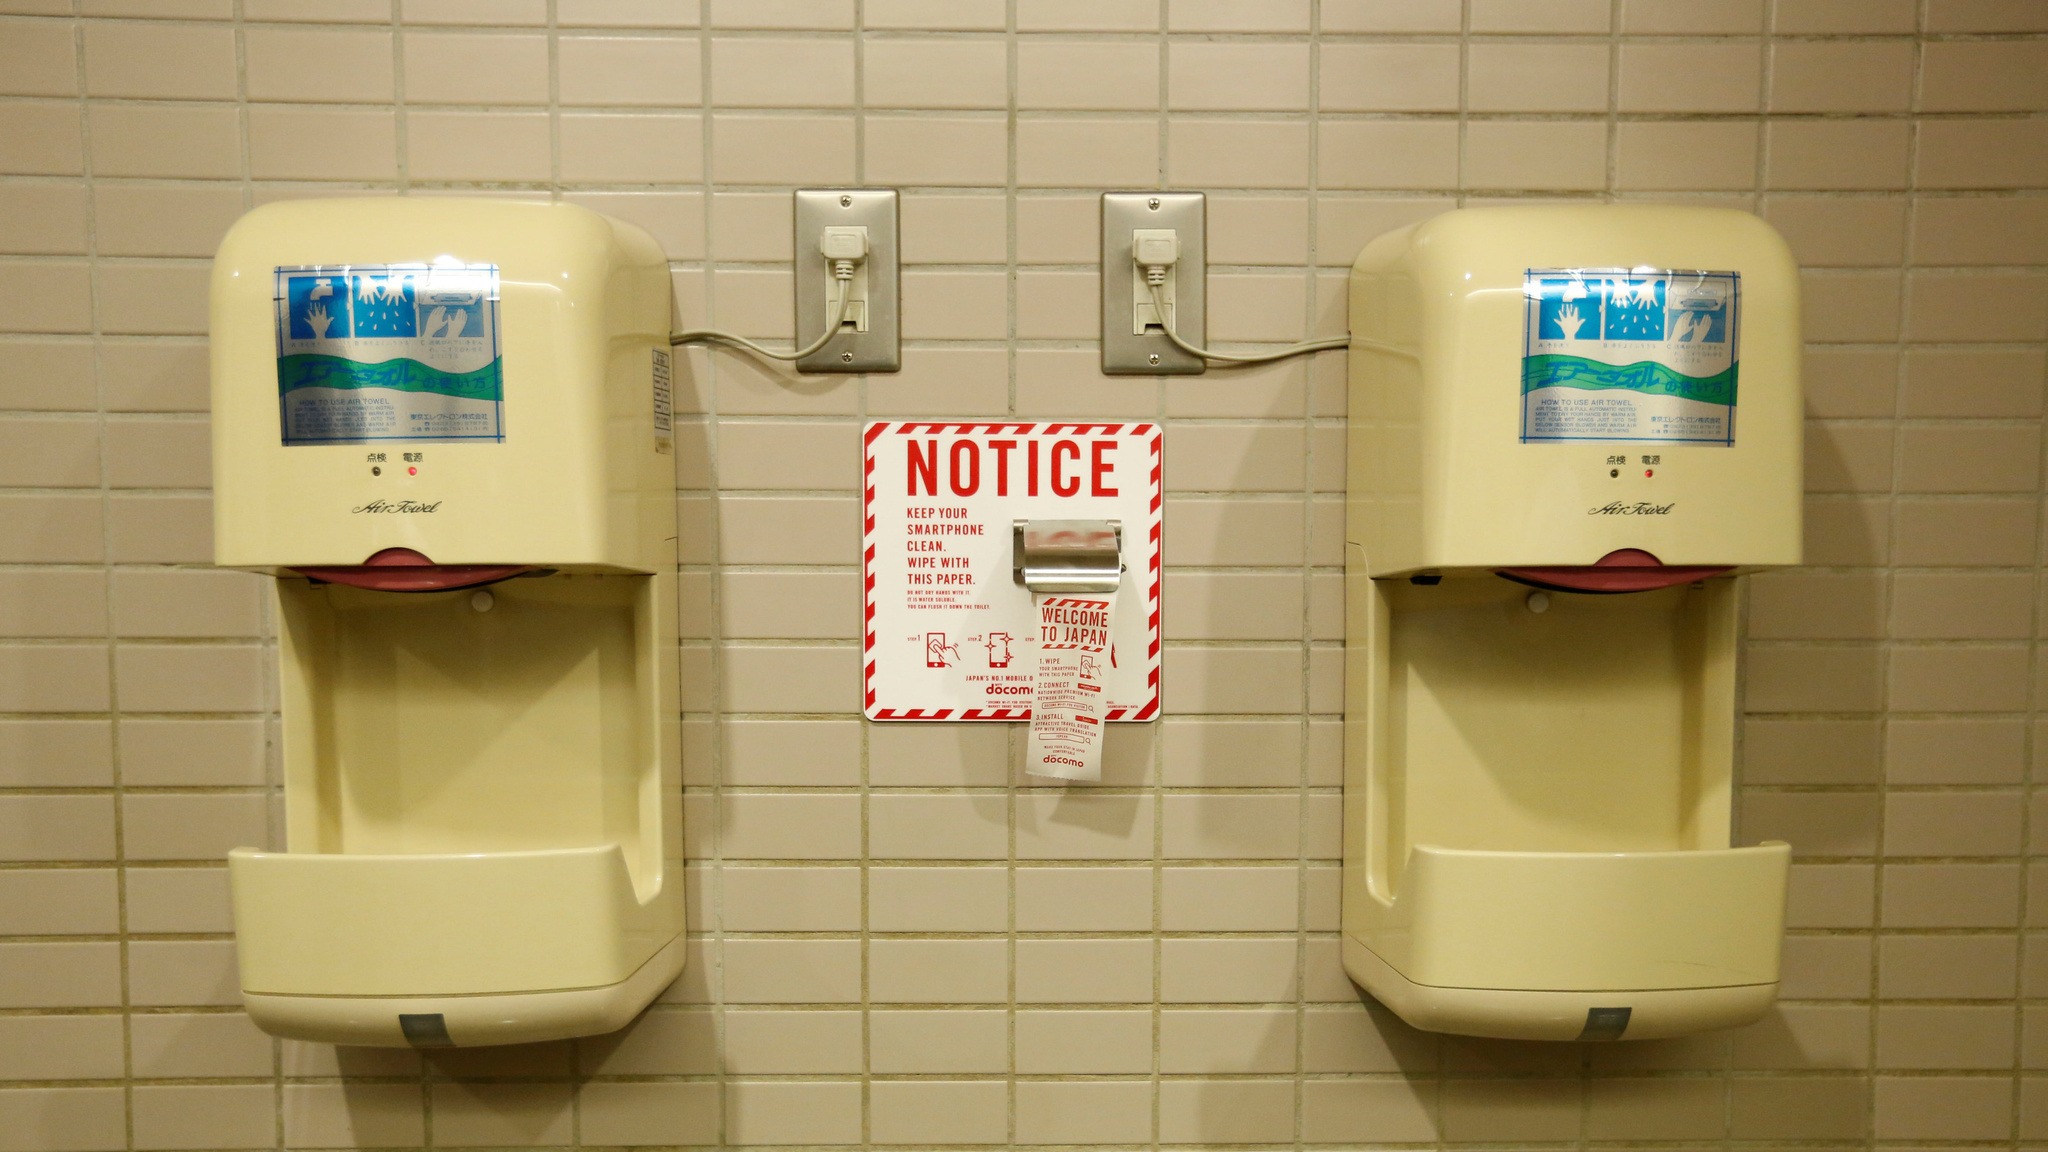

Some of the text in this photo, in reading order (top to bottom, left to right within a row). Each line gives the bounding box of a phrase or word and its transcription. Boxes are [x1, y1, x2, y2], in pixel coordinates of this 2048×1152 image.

[366, 452, 424, 463] 点検 電源
[1606, 455, 1661, 465] 点検 電源
[907, 439, 1118, 497] NOTICE
[907, 508, 968, 519] KEEP YOUR
[907, 524, 984, 535] SMARTPHONE
[907, 541, 947, 552] CLEAN.
[907, 557, 969, 568] WIPE WITH
[908, 573, 976, 585] THIS PAPER.
[1041, 607, 1109, 628] WELCOME
[1041, 626, 1107, 646] TO JAPAN
[1069, 728, 1097, 737] TRANSLATION
[1043, 755, 1084, 768] docomo
